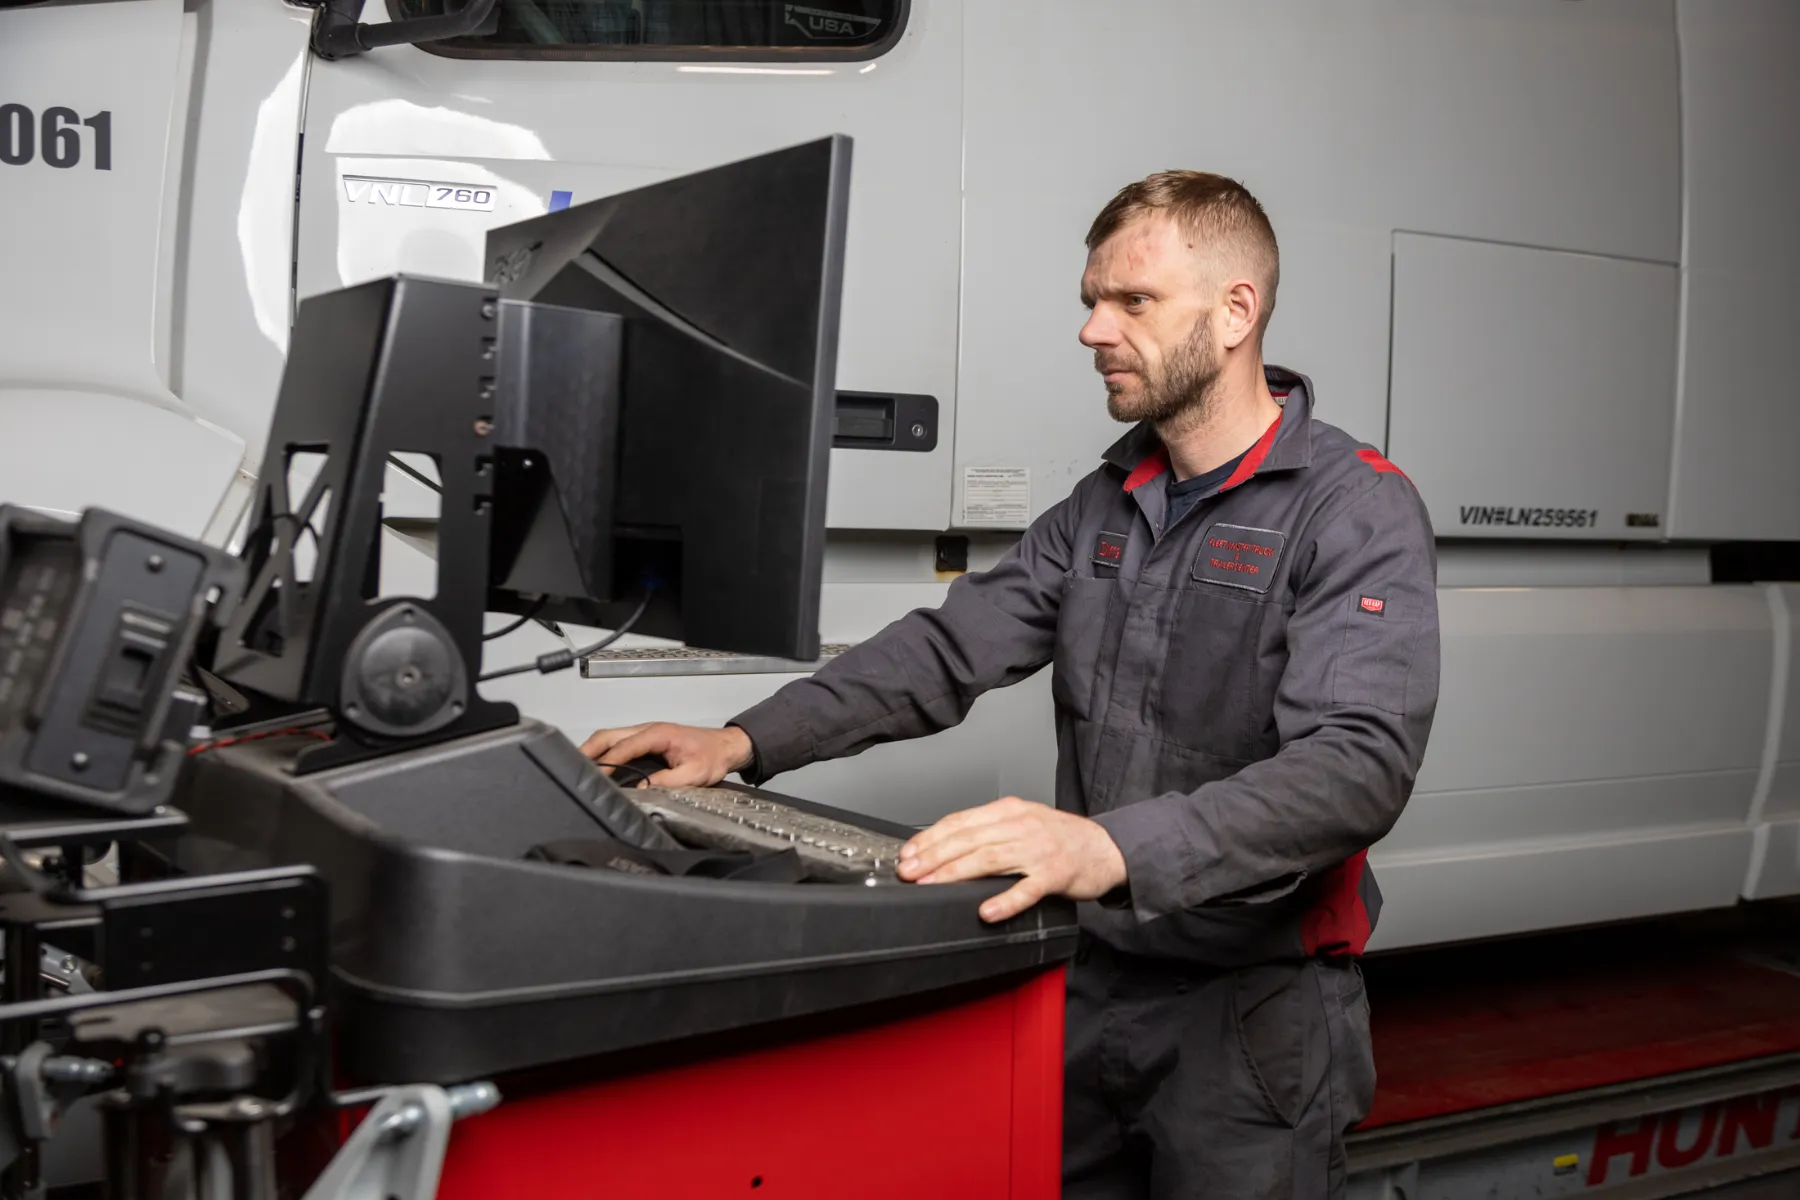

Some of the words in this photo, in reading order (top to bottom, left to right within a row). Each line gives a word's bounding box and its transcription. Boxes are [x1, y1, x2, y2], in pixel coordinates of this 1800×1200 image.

[809, 16, 855, 36] USA
[0, 103, 112, 171] 061
[343, 180, 429, 207] VNL
[436, 187, 491, 205] 760
[1252, 545, 1275, 556] TRUCK
[1211, 559, 1234, 570] TRAILER
